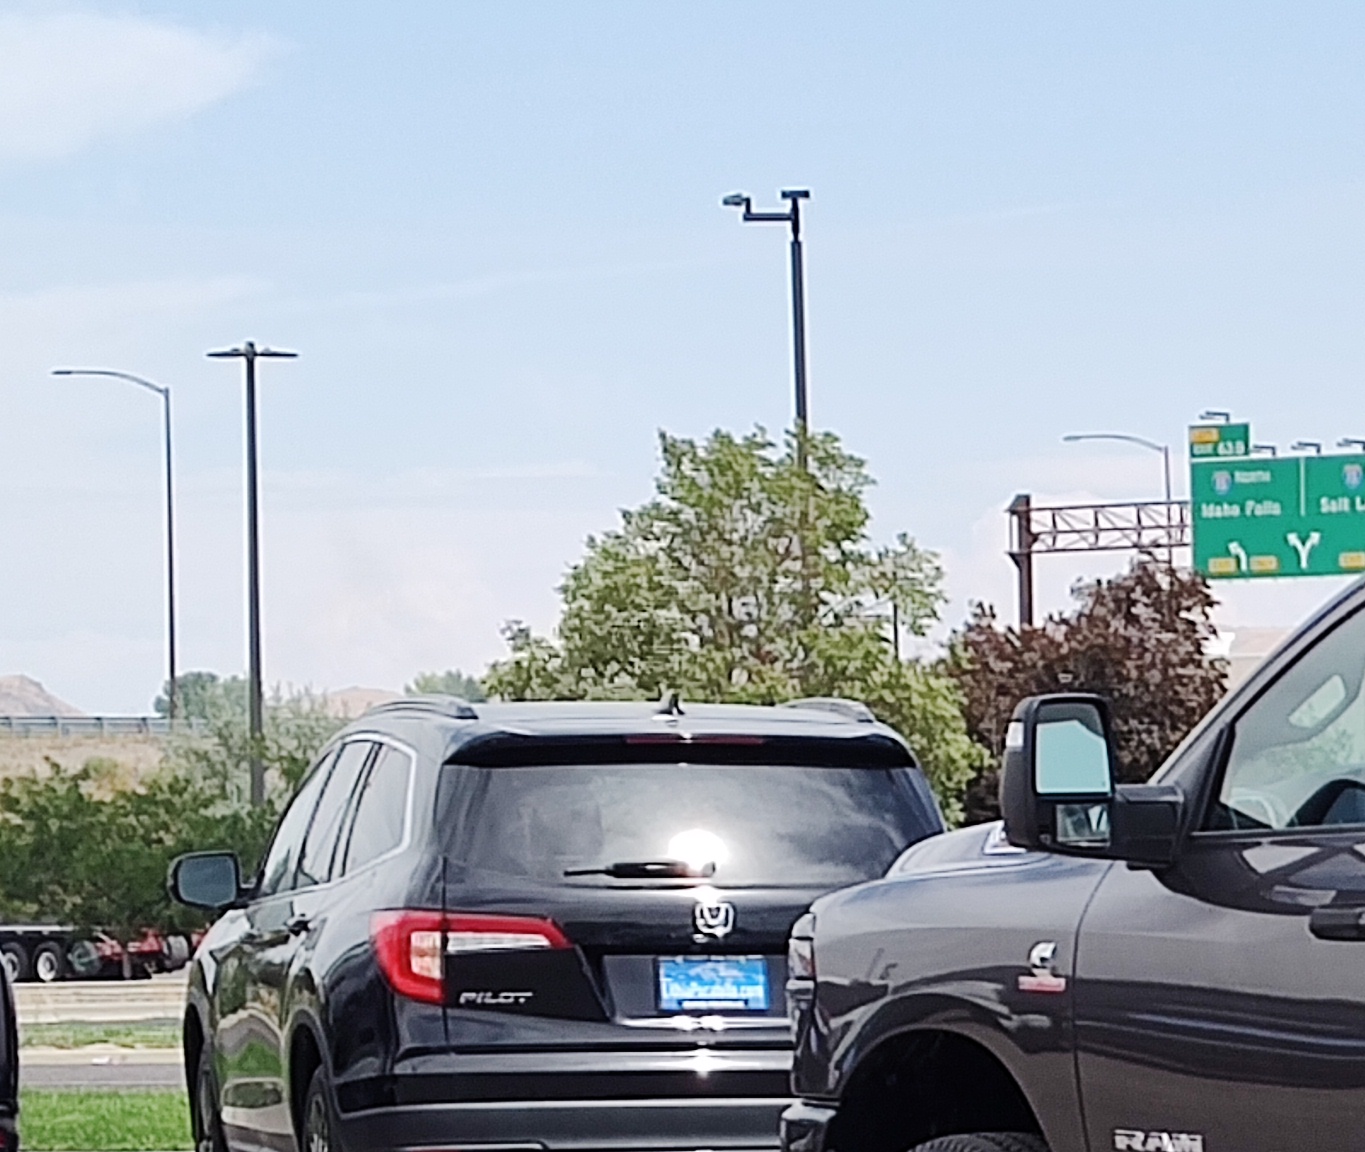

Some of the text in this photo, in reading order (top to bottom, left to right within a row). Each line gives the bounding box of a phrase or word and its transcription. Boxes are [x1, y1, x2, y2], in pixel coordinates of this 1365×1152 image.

[1201, 500, 1281, 518] Idaho Falls
[1320, 496, 1350, 514] Salt
[459, 991, 533, 1004] PILOT
